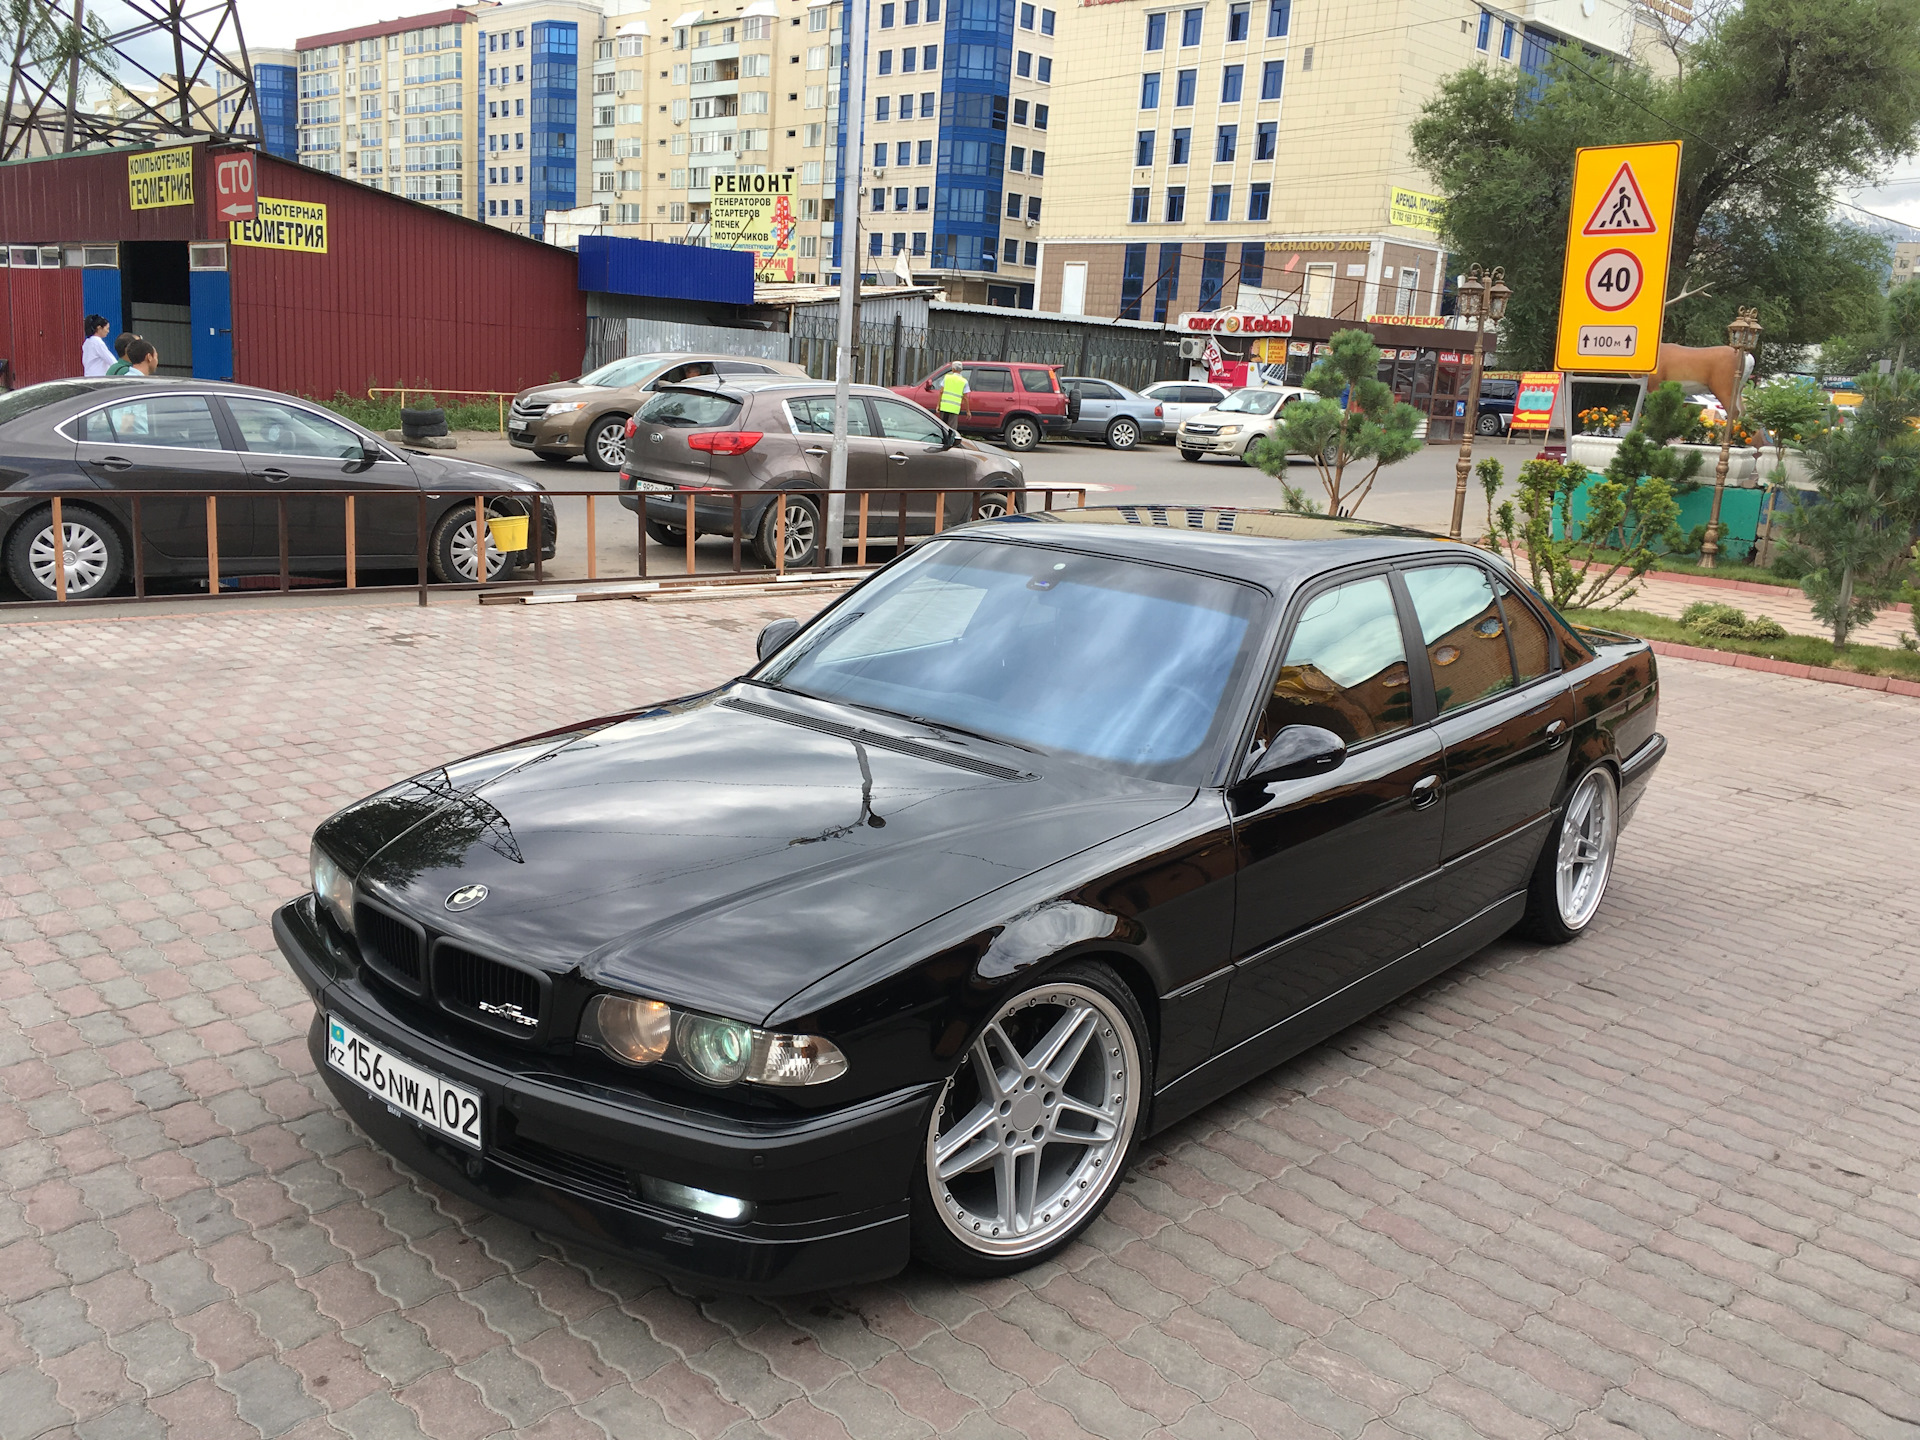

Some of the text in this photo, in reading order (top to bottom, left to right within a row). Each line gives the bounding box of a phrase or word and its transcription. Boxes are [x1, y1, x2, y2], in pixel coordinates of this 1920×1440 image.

[130, 150, 190, 175] КОМПЬЮТЕРНАЯ
[217, 158, 252, 194] СТО
[714, 174, 792, 192] РЕМОНТ
[130, 172, 192, 206] ГЕОМЕТРИЯ
[714, 197, 771, 206] ГЕНЕРАТОРОВ
[258, 202, 323, 221] ПЬЮТЕРНАЯ
[714, 209, 760, 217] СТАРТЕРОВ
[714, 220, 740, 228] ПЕЧЕК
[233, 219, 325, 249] ГЕОМЕТРИЯ
[714, 232, 769, 241] МОТОРЧИКОВ
[1264, 241, 1371, 251] KACHALOVO ZONE
[754, 258, 786, 269] ЕКТРИК
[1597, 267, 1631, 292] 40
[1241, 315, 1292, 333] Kebab
[1369, 315, 1445, 326] АВТОСТЕКЛА
[330, 1043, 345, 1069] KZ
[443, 1089, 479, 1140] 02
